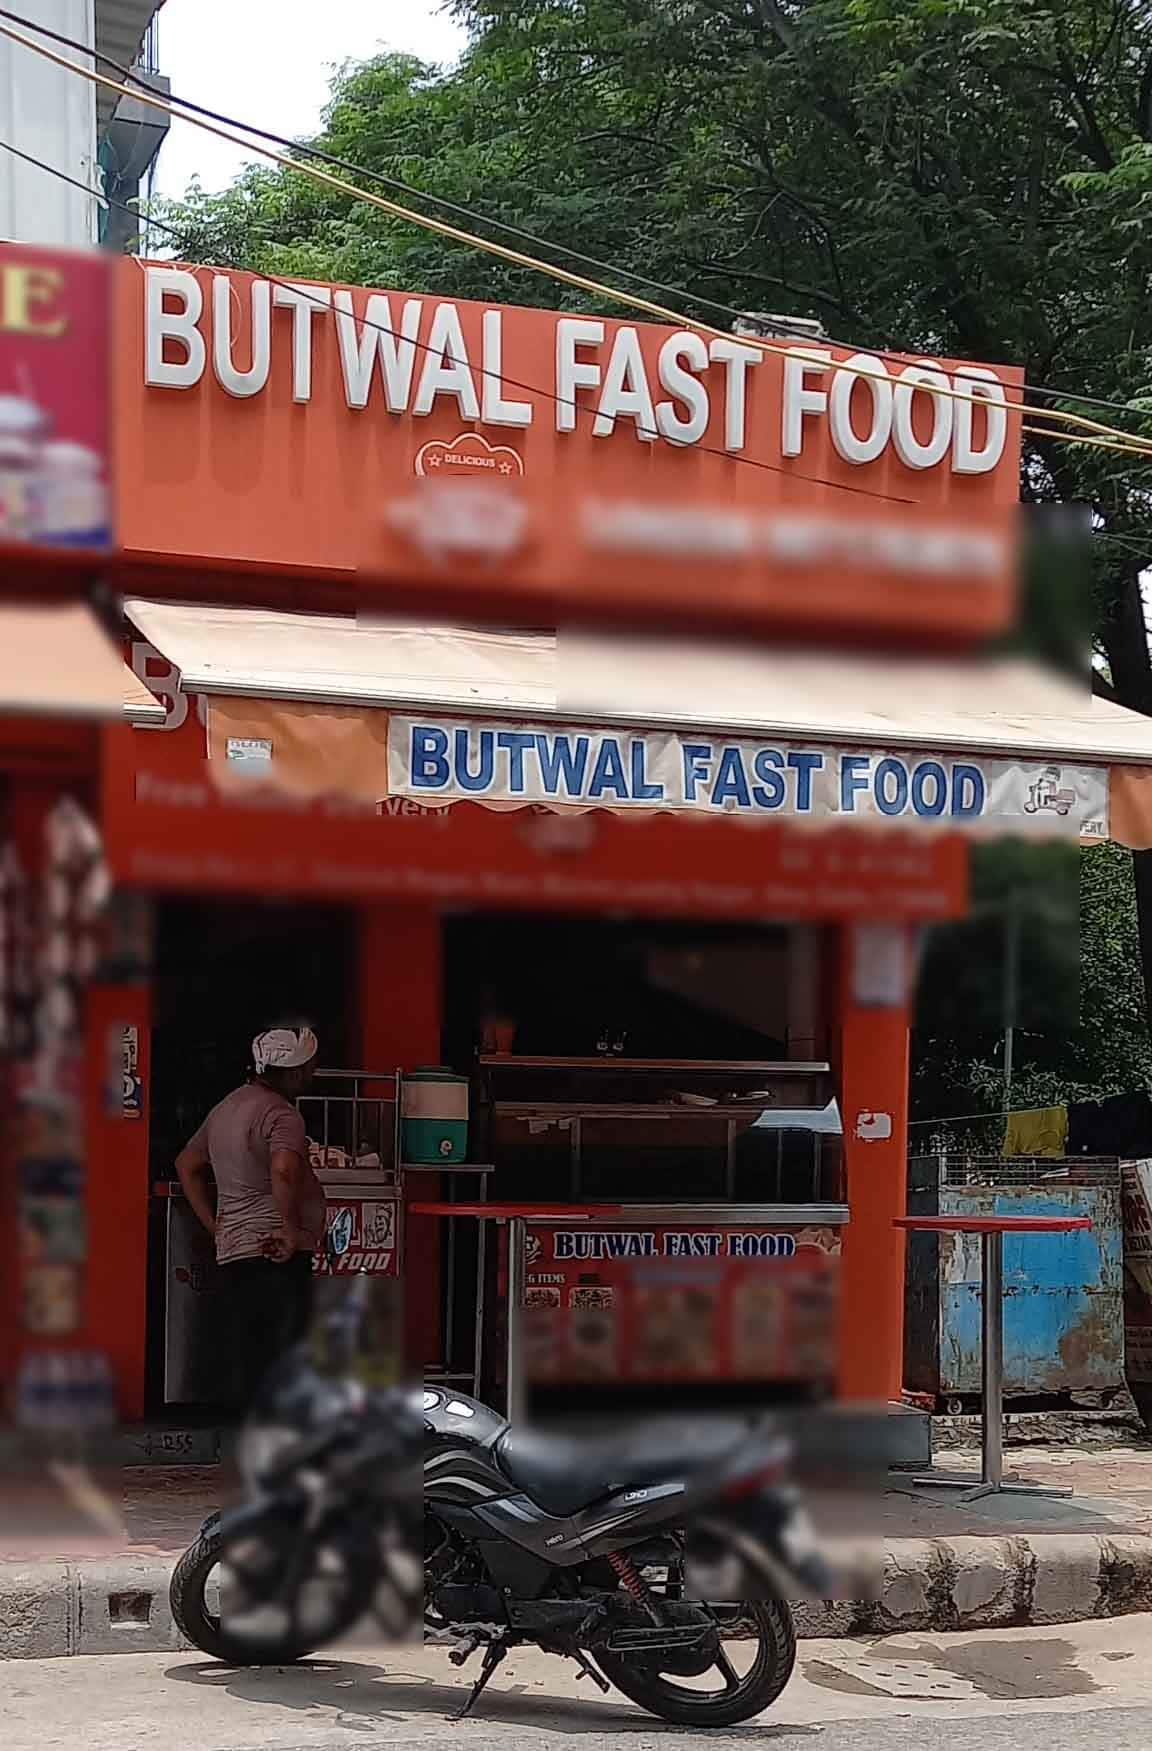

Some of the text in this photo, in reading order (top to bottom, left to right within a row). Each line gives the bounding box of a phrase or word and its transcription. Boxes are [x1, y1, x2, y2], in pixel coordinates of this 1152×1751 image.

[144, 266, 1008, 474] BUTWAL FAST FOOD
[444, 453, 495, 468] DELICIOUS
[409, 723, 665, 801] BUTWAL
[681, 743, 824, 811] FAST
[840, 754, 986, 817] FOOD
[553, 1232, 796, 1259] BUTWAL FAST FOOD
